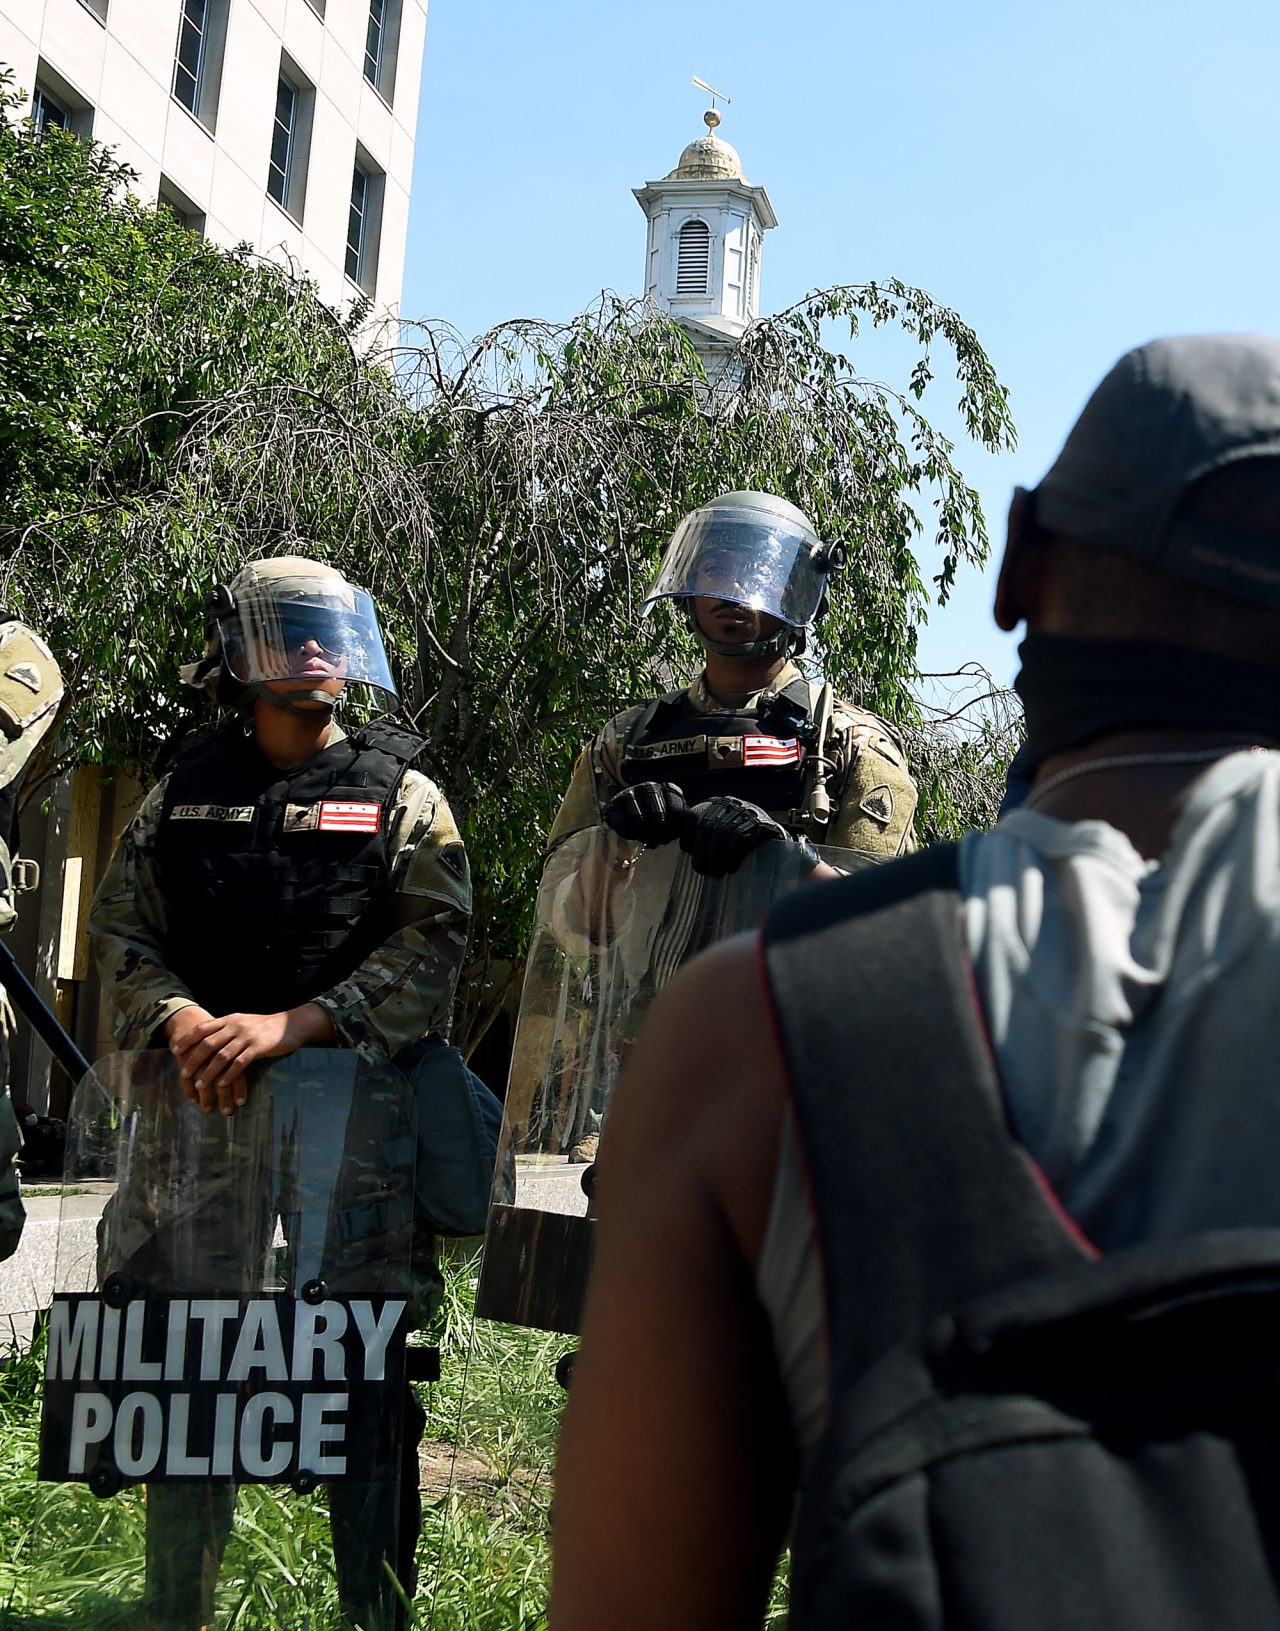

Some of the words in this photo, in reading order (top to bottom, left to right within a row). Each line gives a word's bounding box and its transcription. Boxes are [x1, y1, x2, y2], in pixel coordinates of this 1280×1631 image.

[634, 746, 656, 758] U.S.
[660, 739, 696, 755] ARMY
[179, 806, 200, 817] U.S.
[205, 806, 244, 819] ARMY
[45, 1299, 407, 1381] MILITARY
[68, 1392, 349, 1477] POLICE
